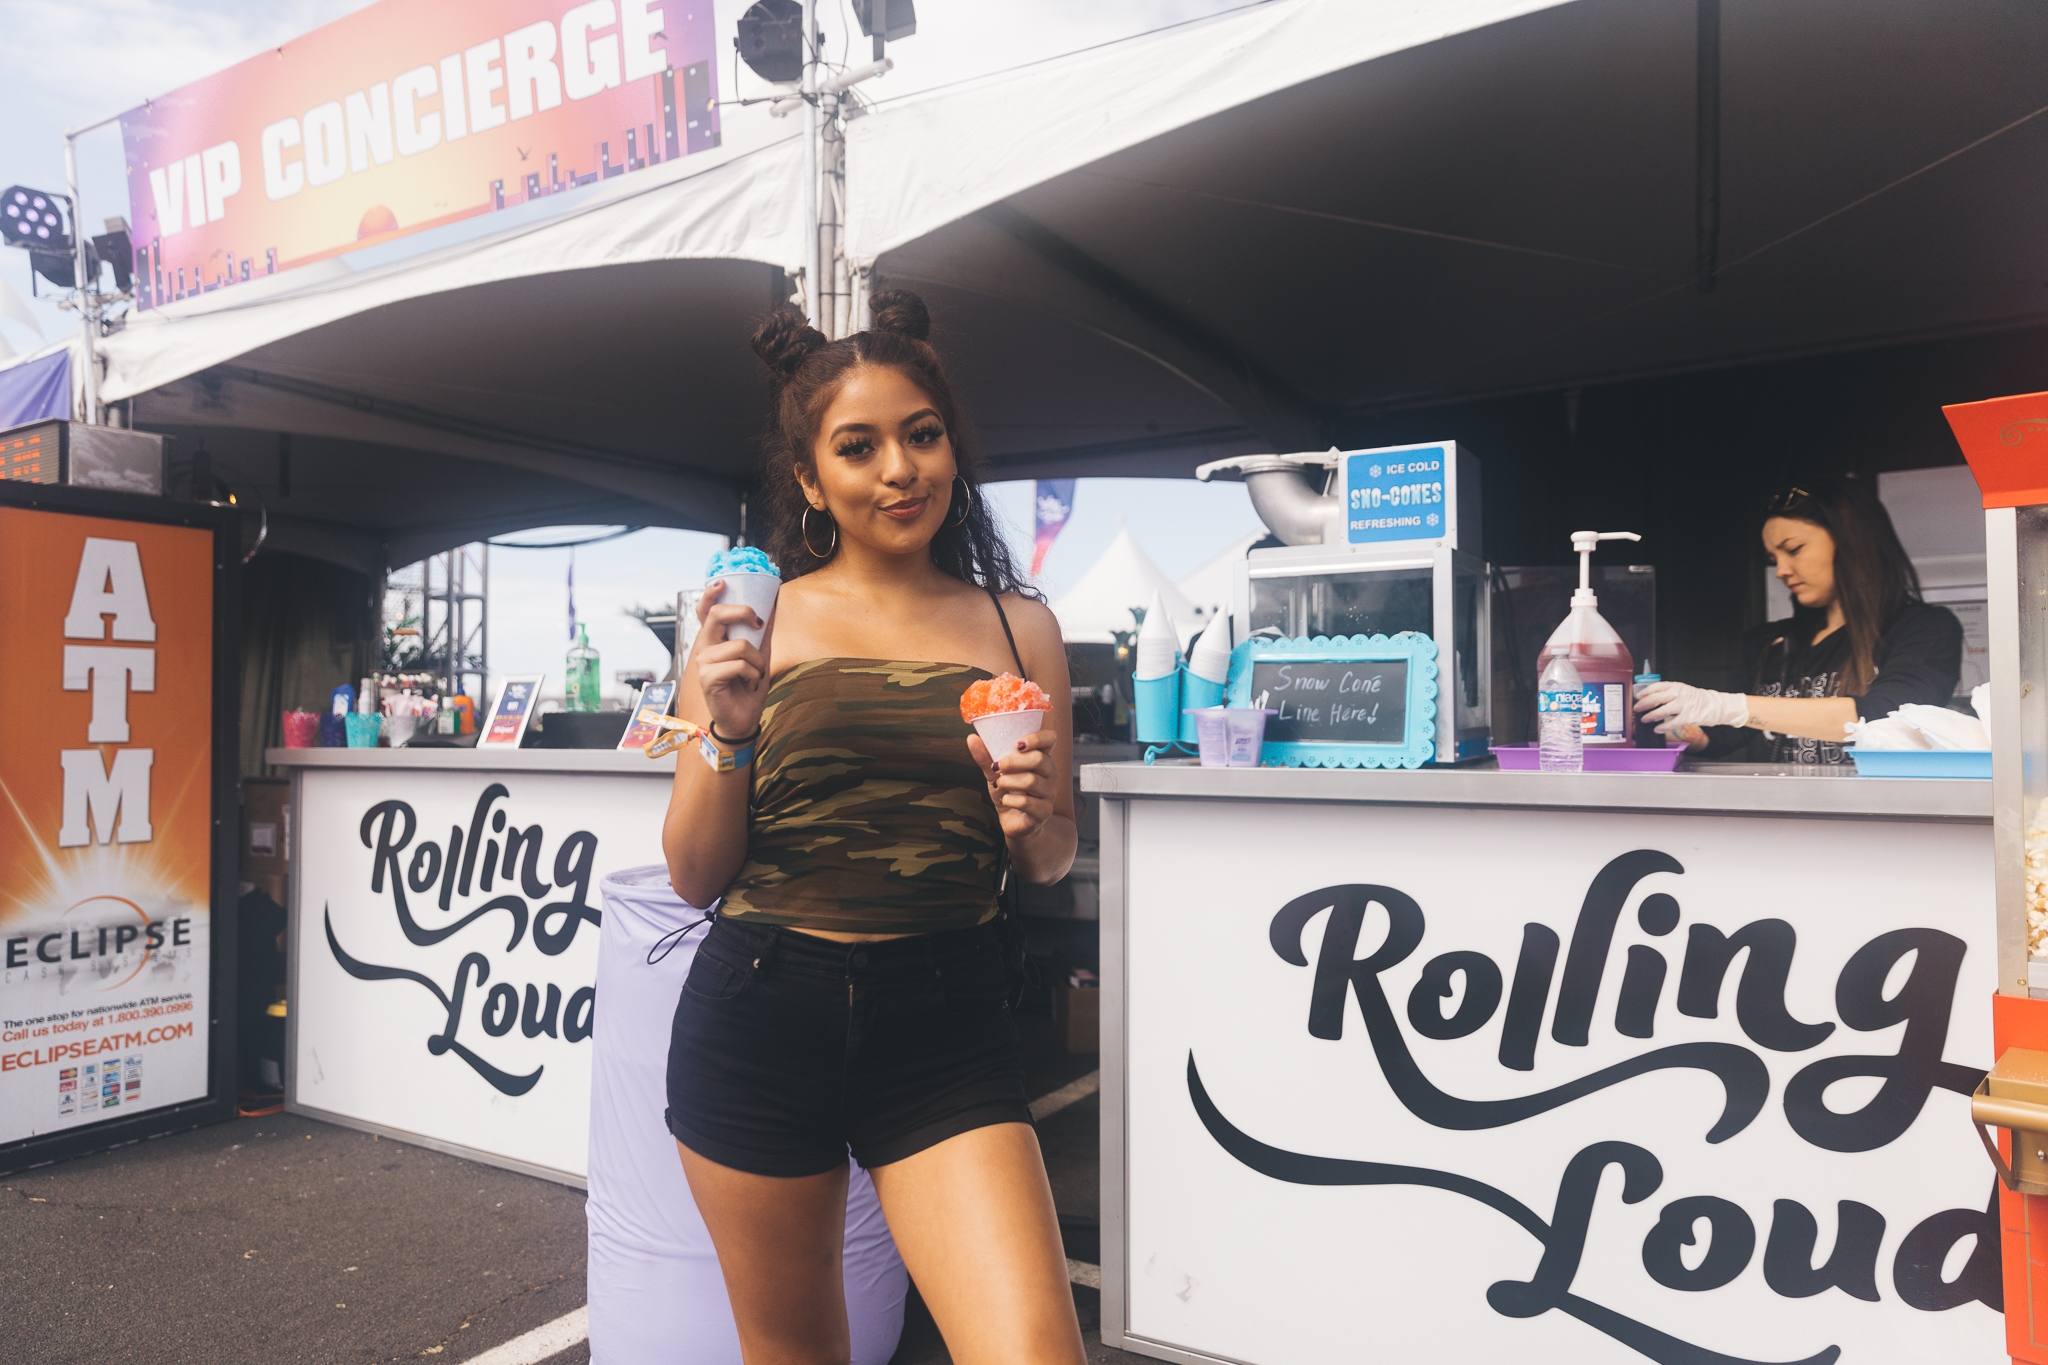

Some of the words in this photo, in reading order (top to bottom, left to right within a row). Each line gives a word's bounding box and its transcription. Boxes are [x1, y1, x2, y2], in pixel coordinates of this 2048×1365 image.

[149, 140, 241, 238] VIP
[261, 0, 669, 201] CONCIERGE
[1386, 463, 1406, 475] ICE
[1407, 460, 1440, 473] COLD
[1350, 481, 1442, 510] SNO-CONES
[1350, 515, 1421, 531] REFRESHING
[60, 536, 156, 847] ATM
[1274, 664, 1330, 691] Snow
[1279, 699, 1320, 721] Line
[1329, 702, 1379, 725] Here!
[360, 782, 602, 956] Rolling
[6, 918, 191, 968] ECLIPSE
[4, 1020, 23, 1029] The
[25, 1016, 45, 1026] one
[47, 1013, 69, 1022] stop
[71, 1009, 84, 1018] for
[86, 1000, 137, 1015] nationwide
[140, 996, 159, 1006] ATM
[1269, 849, 1985, 1152] Rolling
[2, 1028, 29, 1042] Call
[32, 1026, 49, 1037] us
[52, 1019, 89, 1032] today
[92, 1016, 104, 1027] at
[1, 1021, 193, 1072] ECLIPSEATM.COM
